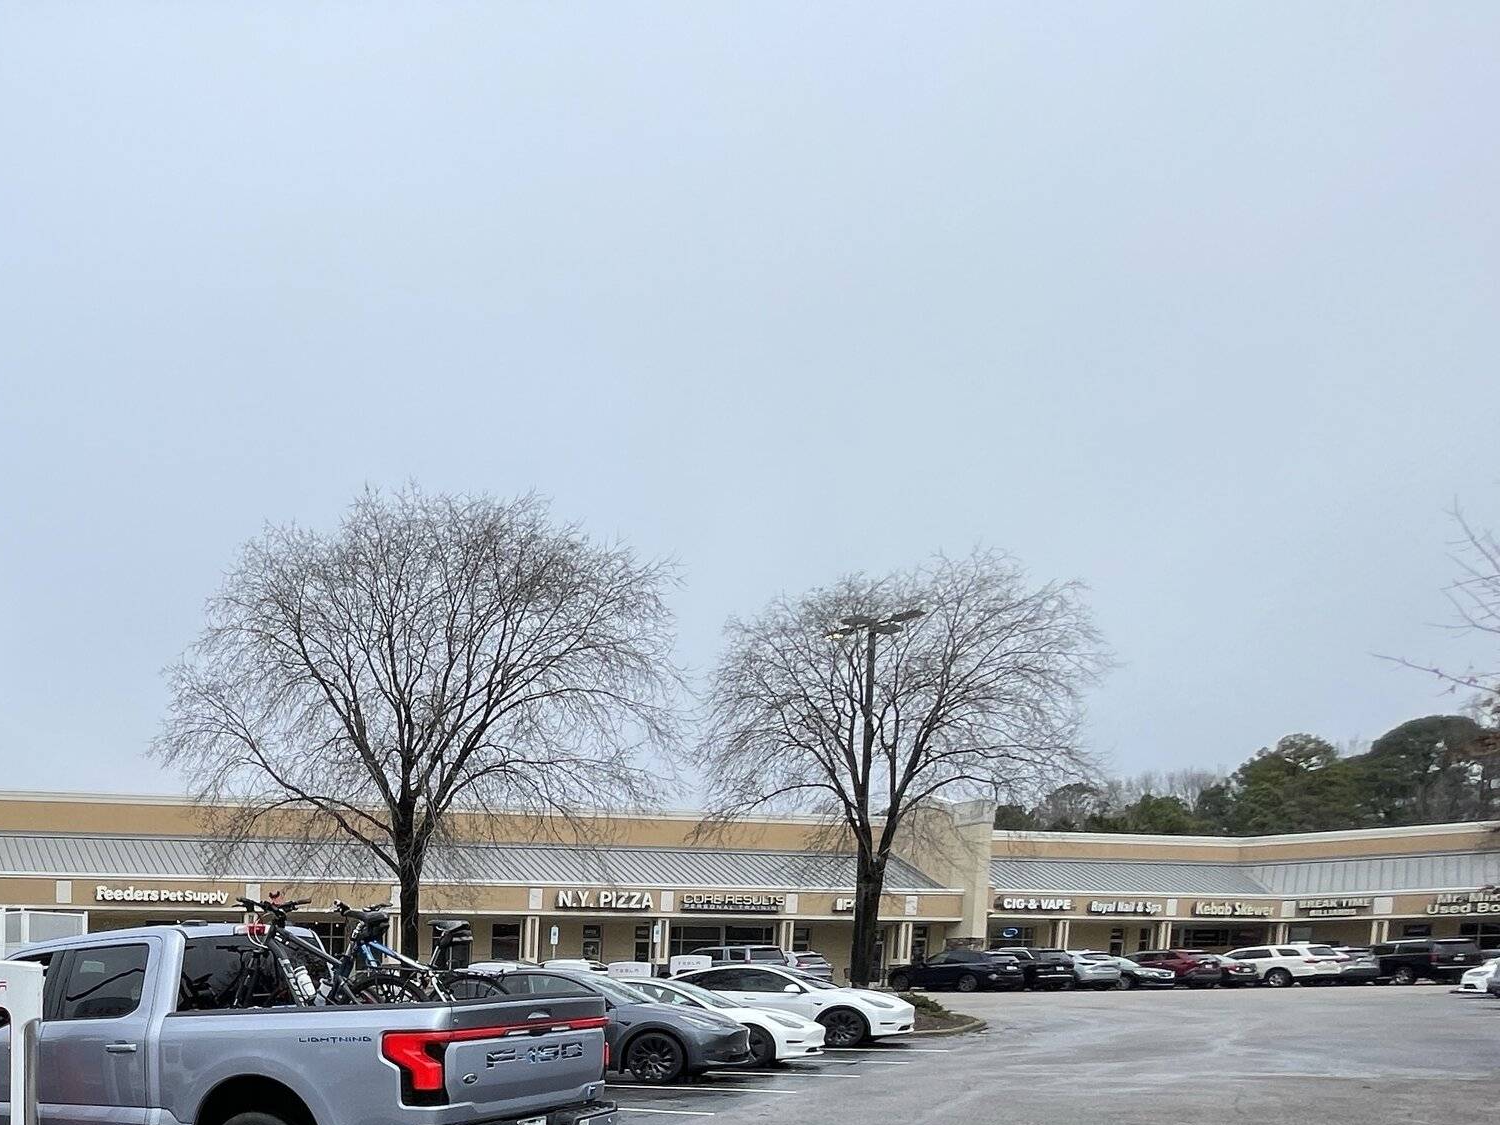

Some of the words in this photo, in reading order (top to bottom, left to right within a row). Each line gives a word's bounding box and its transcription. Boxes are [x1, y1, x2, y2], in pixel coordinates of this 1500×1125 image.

[96, 885, 159, 902] Feeders
[160, 890, 184, 902] Pet
[184, 890, 229, 905] Supply
[558, 890, 594, 908] N.Y.
[599, 891, 654, 909] PIZZA
[683, 893, 722, 904] CORE
[725, 894, 785, 906] RESULTS
[1003, 898, 1025, 909] CIG
[1027, 898, 1038, 910] &
[1040, 899, 1072, 910] VAPE
[1091, 900, 1116, 914] Royal
[1136, 901, 1144, 913] &
[1145, 901, 1162, 914] Spa
[1196, 901, 1233, 915] Kebab
[1234, 902, 1275, 916] Skewer
[1426, 902, 1472, 915] Used
[486, 1041, 583, 1069] F-150
